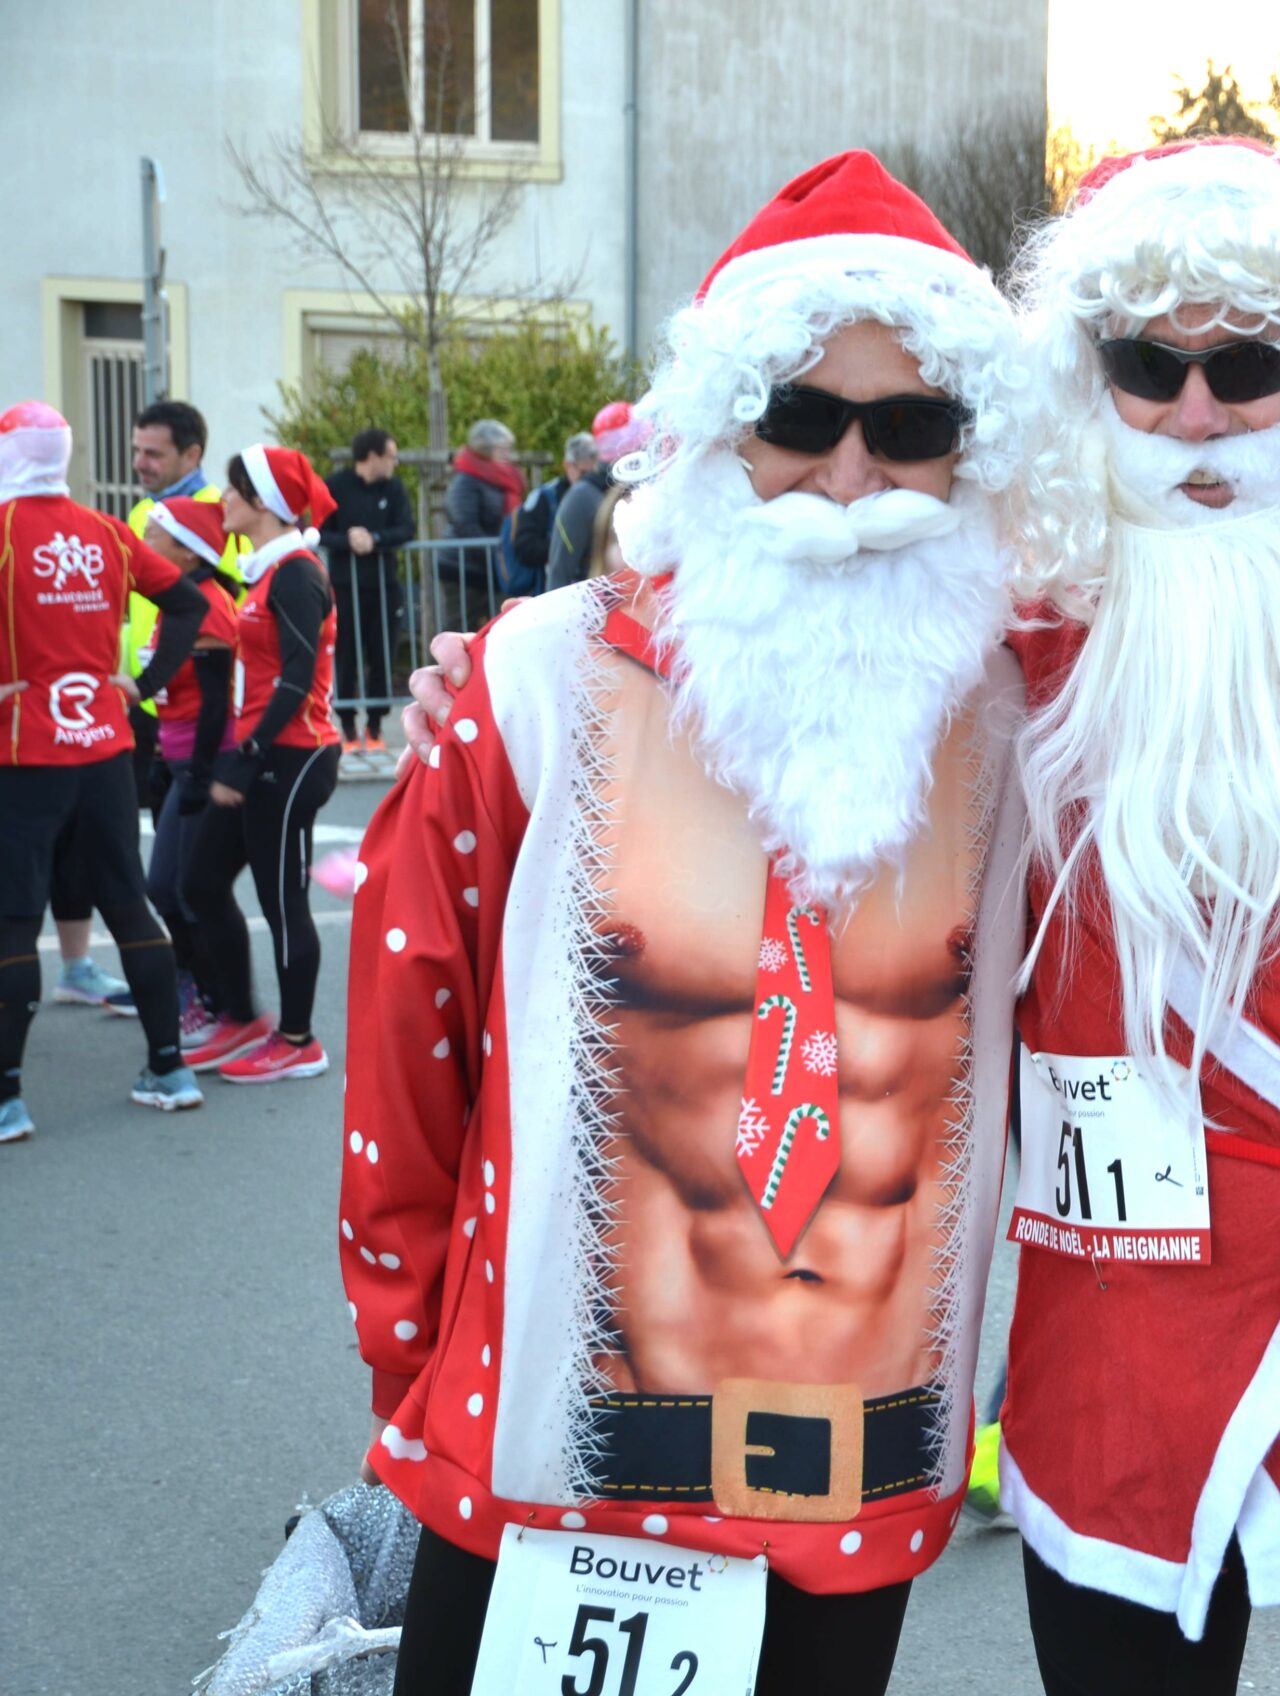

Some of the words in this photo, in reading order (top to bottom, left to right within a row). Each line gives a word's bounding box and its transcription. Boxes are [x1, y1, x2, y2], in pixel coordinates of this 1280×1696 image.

[54, 723, 115, 747] Angers
[1107, 1159, 1127, 1221] 1
[1015, 1216, 1049, 1246] RONDE
[1049, 1226, 1058, 1250] DE
[1059, 1228, 1085, 1256] NOËL
[1093, 1234, 1110, 1258] LA
[1113, 1236, 1201, 1260] MEIGNANNE
[569, 1545, 703, 1592] Bouvet
[631, 1593, 653, 1603] pour
[654, 1596, 689, 1607] passion
[561, 1603, 649, 1696] 51
[669, 1650, 699, 1696] 2
